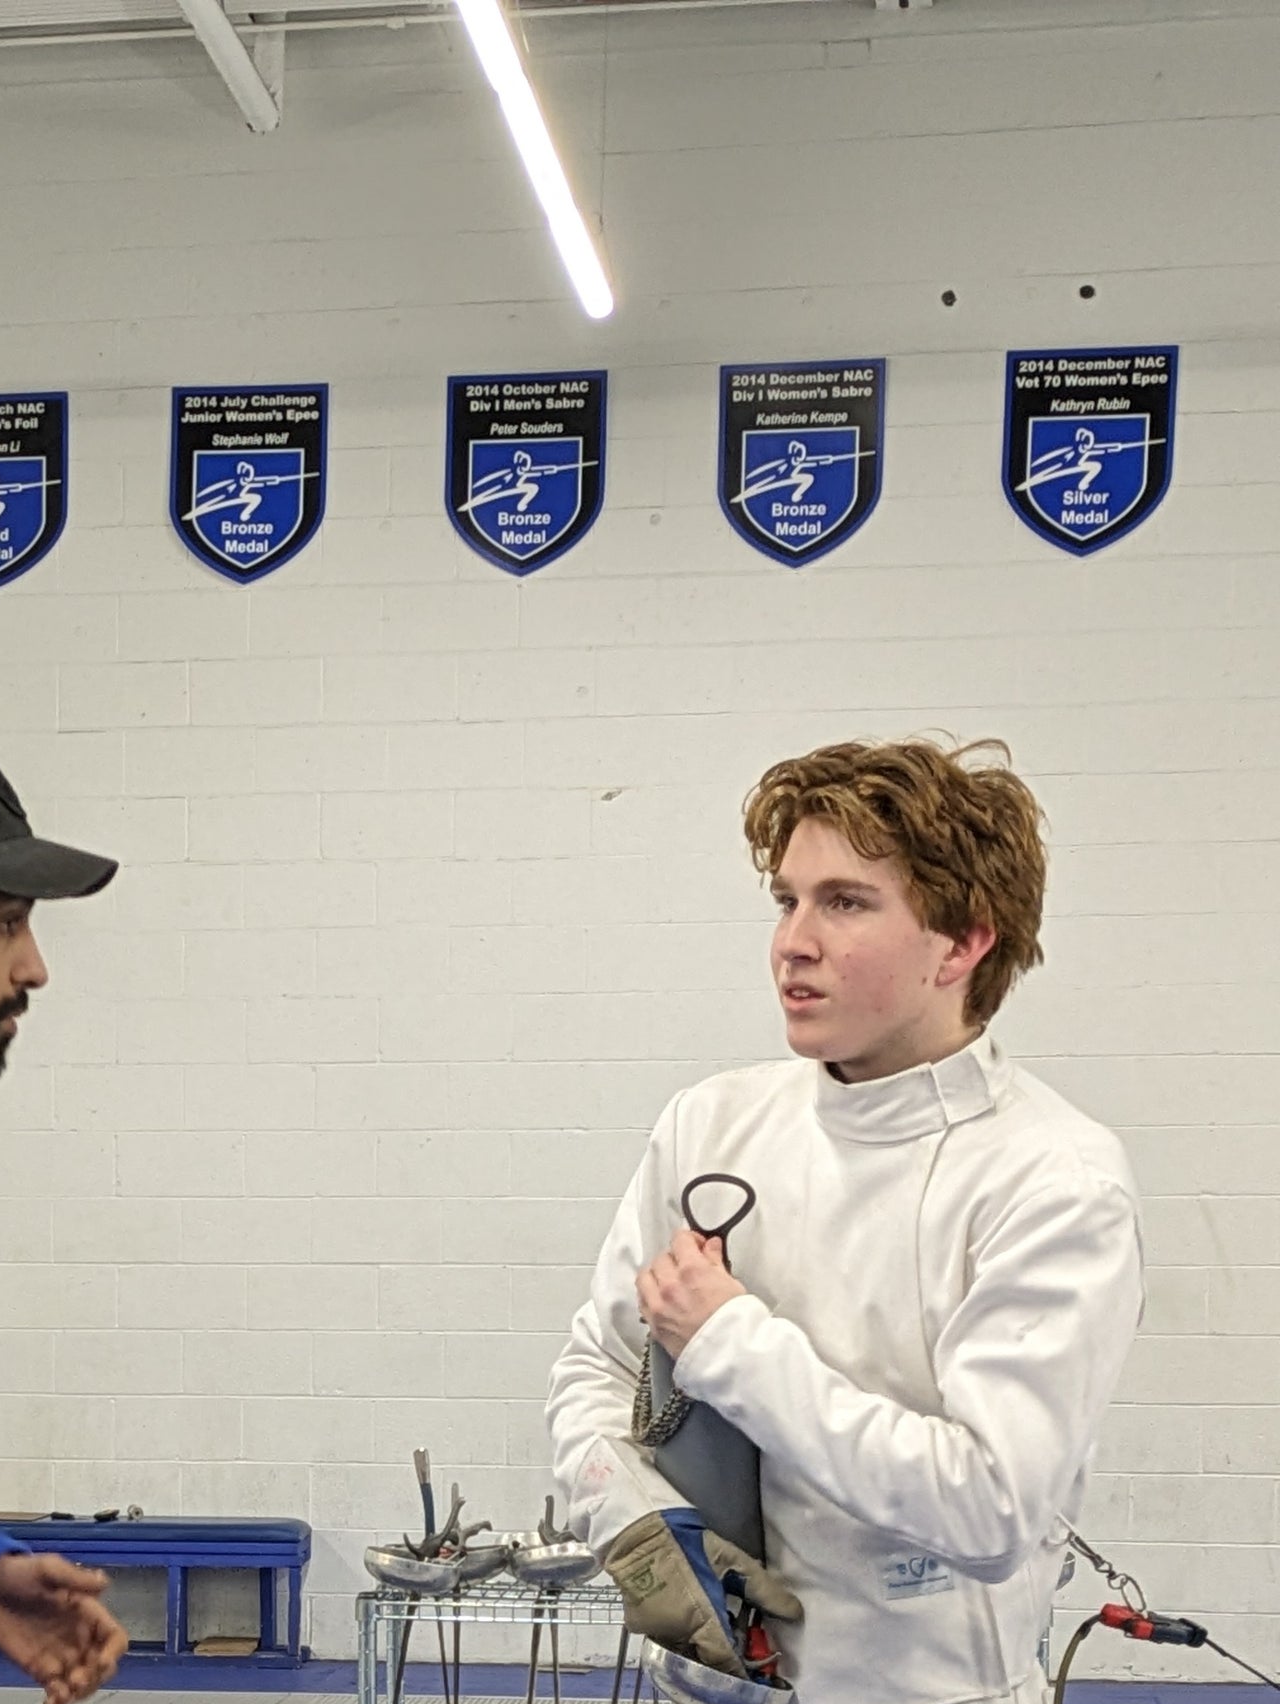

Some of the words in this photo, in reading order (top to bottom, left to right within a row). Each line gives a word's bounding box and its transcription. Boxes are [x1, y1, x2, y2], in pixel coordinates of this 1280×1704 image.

[1019, 360, 1054, 373] 2014
[1058, 358, 1131, 371] December
[1134, 356, 1166, 369] NAC
[732, 374, 766, 387] 2014
[770, 372, 840, 385] December
[843, 369, 874, 382] NAC
[1015, 376, 1040, 389] Vet
[1043, 375, 1061, 388] 70
[1064, 372, 1128, 386] Women's
[1131, 372, 1168, 387] Epee
[466, 385, 499, 397] 2014
[502, 383, 557, 396] October
[560, 381, 589, 393] NAC
[732, 390, 755, 403] Div
[767, 387, 828, 400] Women's
[831, 385, 873, 398] Sabre
[17, 402, 45, 414] NAC
[185, 396, 217, 408] 2014
[220, 395, 248, 409] July
[251, 394, 317, 408] Challenge
[470, 400, 491, 412] Div
[503, 398, 542, 411] Men's
[545, 397, 585, 409] Sabre
[1050, 399, 1095, 414] Kathryn
[1096, 397, 1131, 410] Rubin
[14, 417, 38, 429] Foil
[181, 411, 222, 423] Junior
[225, 410, 283, 423] Women's
[286, 410, 319, 423] Epee
[756, 412, 808, 426] Katherine
[490, 423, 518, 435] Peter
[520, 421, 564, 434] Souders
[10, 441, 21, 453] Li
[212, 433, 263, 448] Stephanie
[265, 432, 290, 445] Wolf
[1063, 490, 1110, 506] Silver
[771, 502, 827, 517] Bronze
[1061, 509, 1109, 525] Medal
[498, 511, 551, 526] Bronze
[221, 520, 273, 535] Bronze
[775, 520, 822, 536] Medal
[501, 530, 546, 545] Medal
[225, 539, 269, 554] Medal
